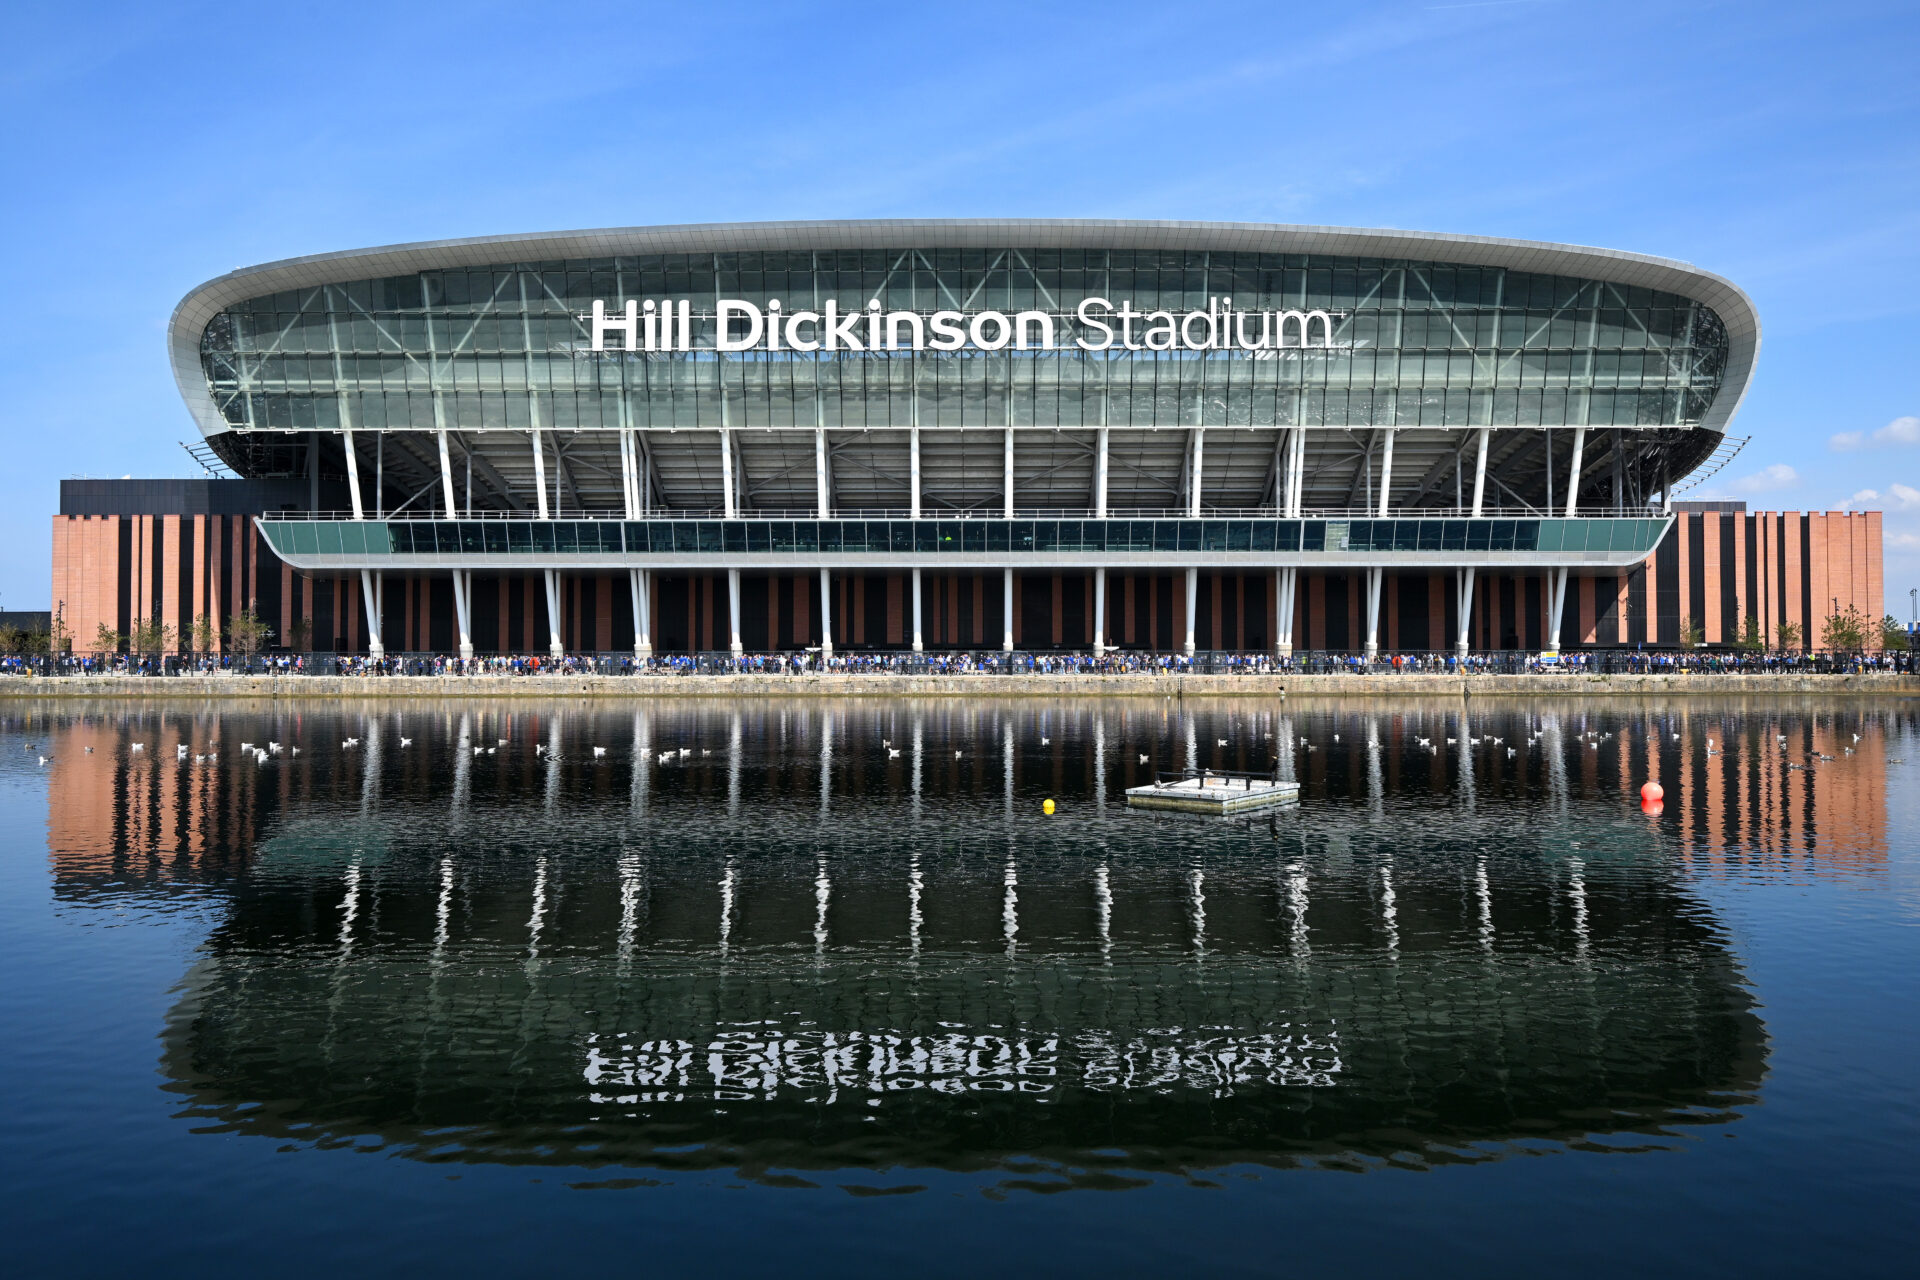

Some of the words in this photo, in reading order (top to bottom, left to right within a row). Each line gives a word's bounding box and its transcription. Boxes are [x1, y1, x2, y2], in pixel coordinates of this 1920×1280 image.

[592, 299, 690, 352] Hill
[716, 298, 1056, 352] Dickinson
[1075, 296, 1333, 351] Stadium
